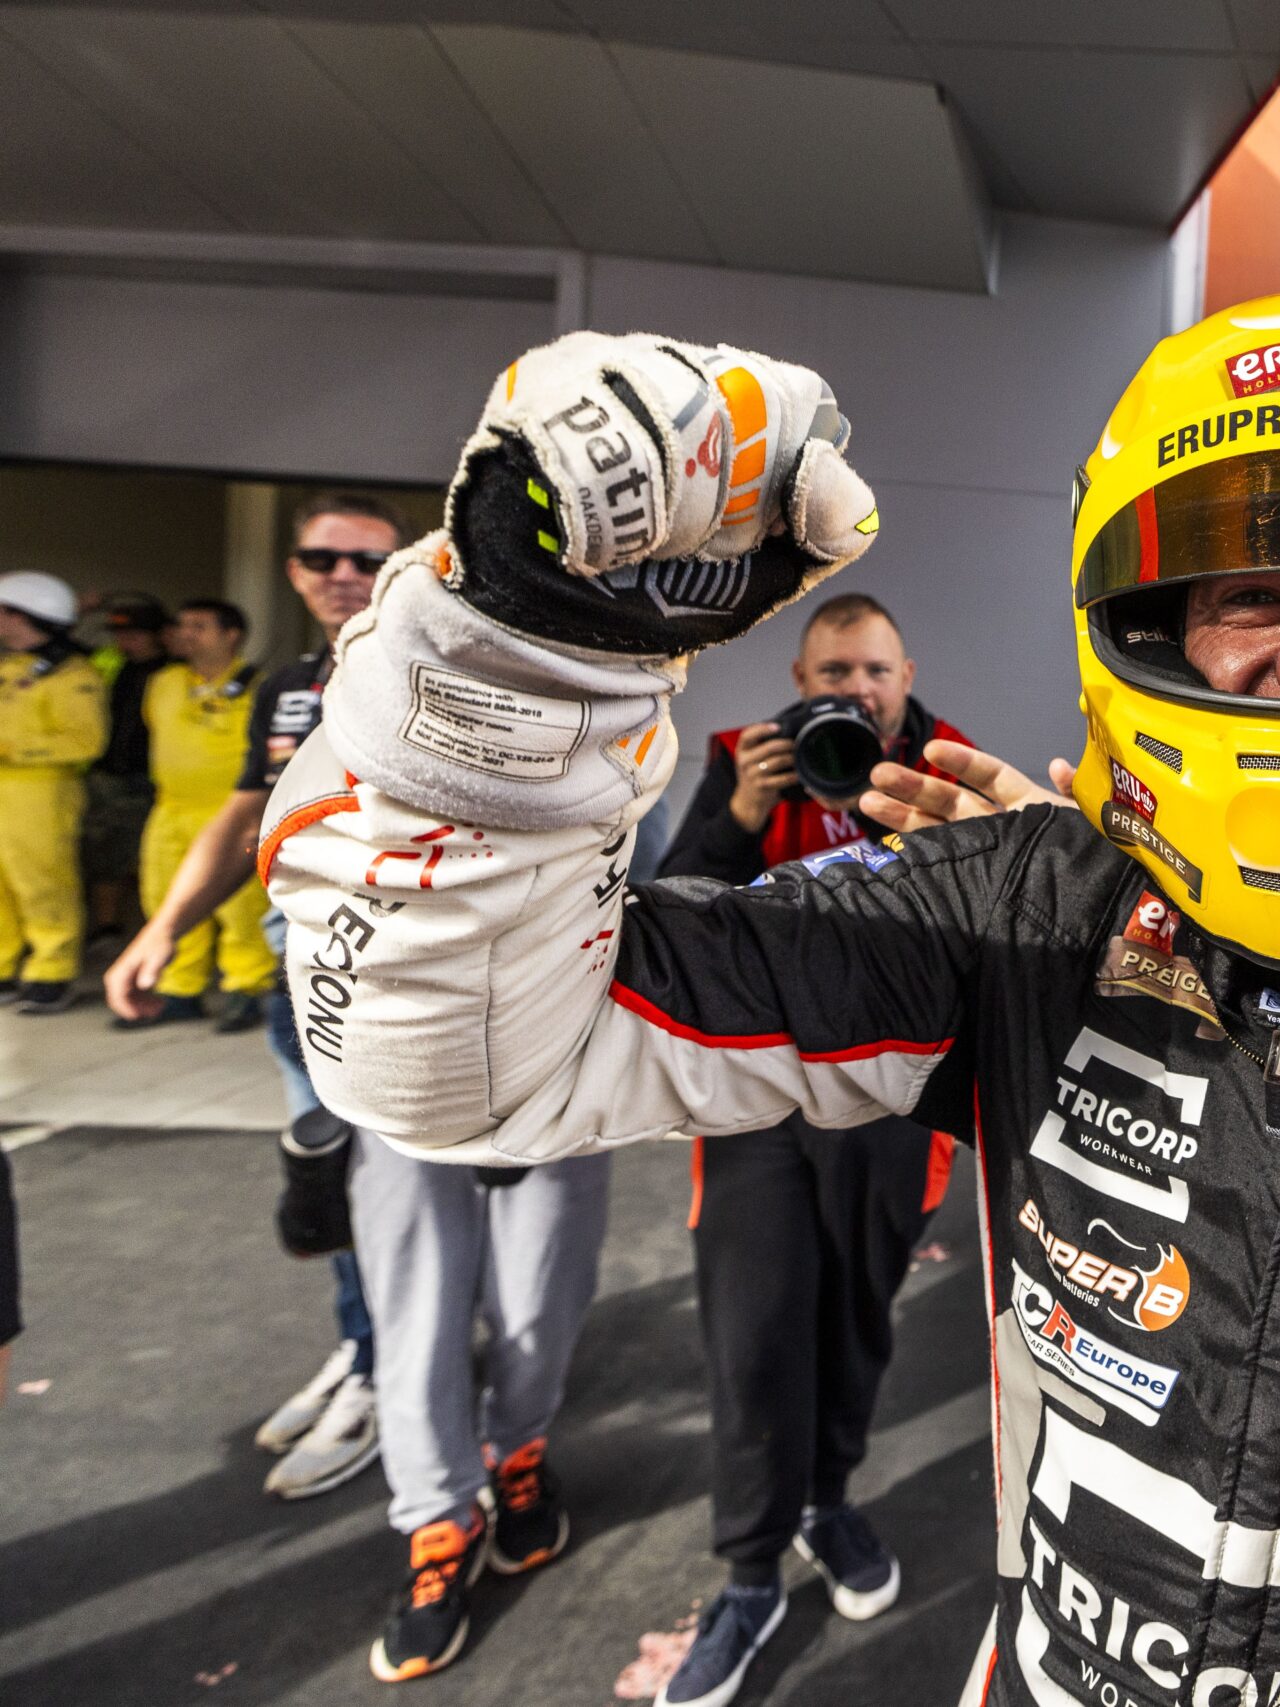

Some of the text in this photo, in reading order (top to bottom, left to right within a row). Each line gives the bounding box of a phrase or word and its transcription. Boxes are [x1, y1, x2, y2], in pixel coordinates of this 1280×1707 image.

[543, 396, 650, 567] patin
[1111, 811, 1186, 875] PRESTIGE
[1056, 1077, 1198, 1165] TRICORP
[1080, 1134, 1153, 1176] WORKWEAR
[1018, 1199, 1139, 1302] SUPER
[1143, 1283, 1185, 1318] B
[1062, 1275, 1101, 1308] batteries
[1011, 1256, 1168, 1396] TCR Europe
[1044, 1347, 1077, 1378] SERIES
